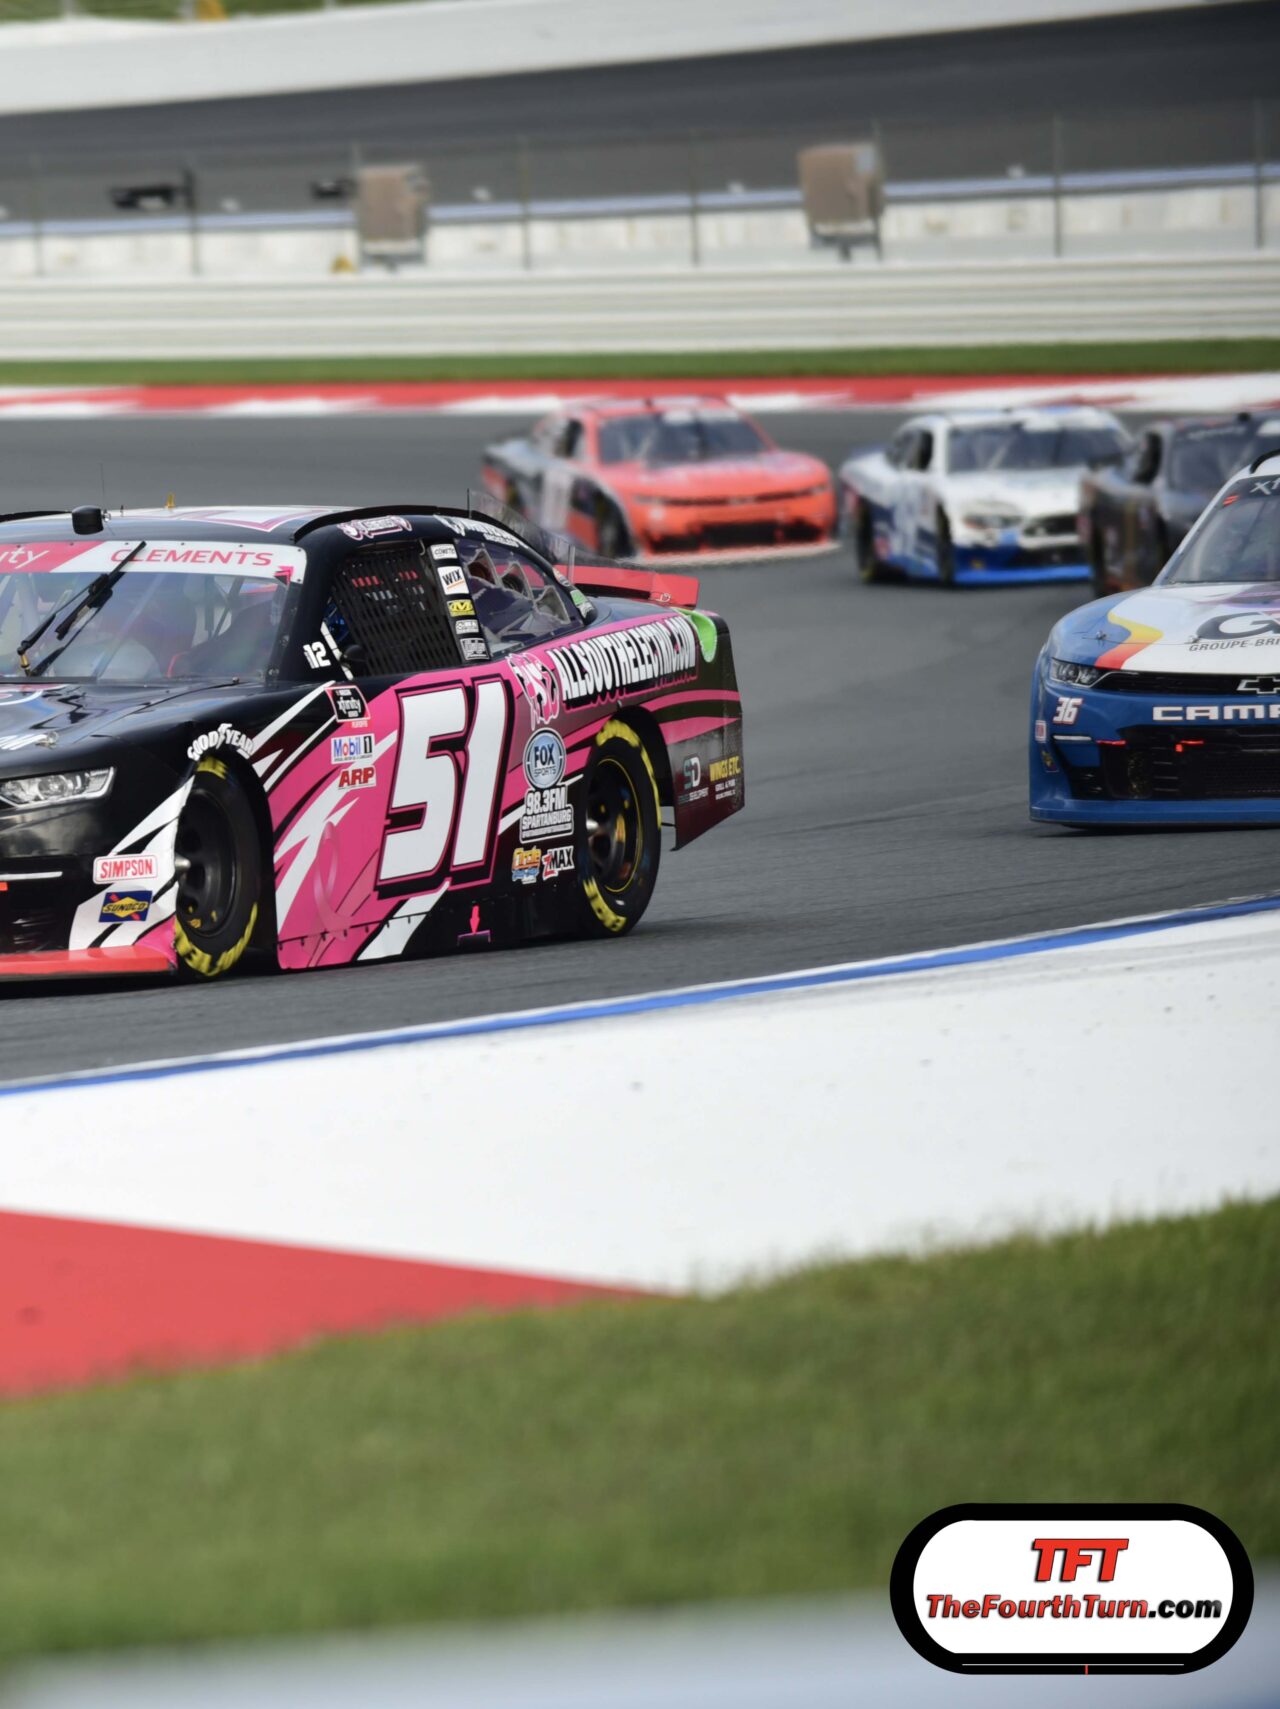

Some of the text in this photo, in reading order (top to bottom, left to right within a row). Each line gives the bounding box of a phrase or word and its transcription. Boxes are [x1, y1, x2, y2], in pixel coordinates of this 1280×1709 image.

[442, 569, 462, 586] WIX
[303, 641, 331, 669] 12
[1053, 697, 1084, 725] 36
[187, 723, 255, 761] GOODYEAR
[334, 736, 373, 757] Mobil 1
[534, 744, 555, 768] FOX
[338, 767, 374, 788] ARP
[377, 677, 507, 886] 51
[526, 786, 566, 815] 98.3FM
[522, 808, 572, 830] SPARTANBURG
[100, 859, 153, 879] SIMPSON
[104, 902, 147, 912] SUNOCO
